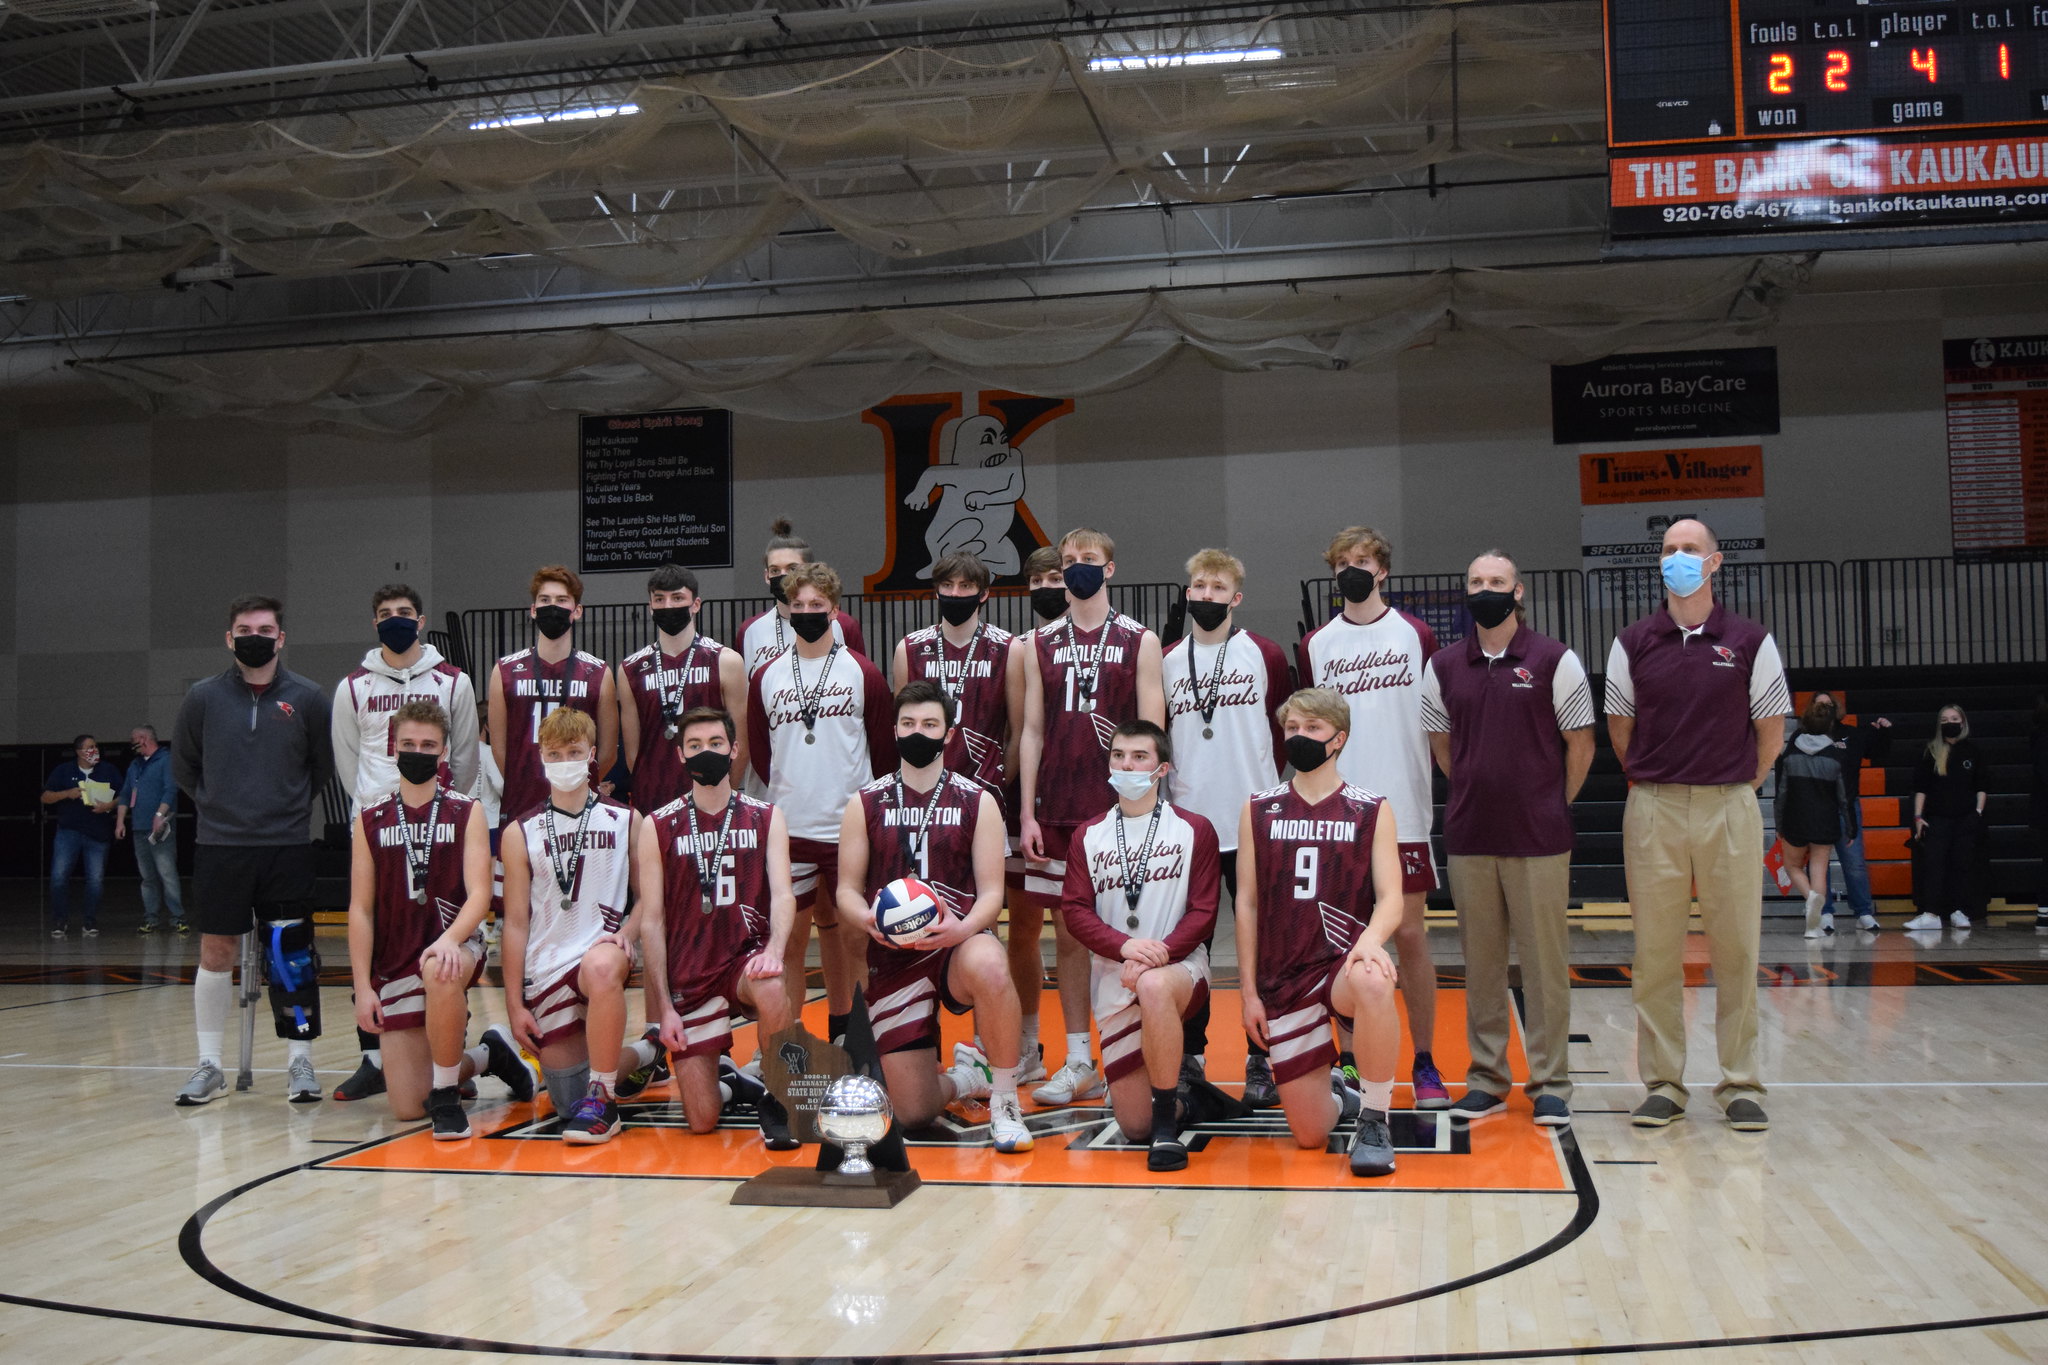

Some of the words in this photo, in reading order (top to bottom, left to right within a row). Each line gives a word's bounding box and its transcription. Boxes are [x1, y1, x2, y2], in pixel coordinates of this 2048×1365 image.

[1750, 22, 1797, 44] fouls
[1881, 12, 1947, 38] player
[1768, 53, 1793, 94] 2
[1826, 50, 1849, 91] 2
[1911, 48, 1936, 83] 4
[2000, 43, 2009, 80] 1
[1758, 108, 1797, 126] won
[1892, 100, 1943, 124] game
[1628, 161, 1697, 198] THE
[1714, 154, 1812, 194] BANK
[1829, 152, 1873, 188] OF
[1663, 202, 1805, 223] 920-766-4674
[1582, 381, 1654, 398] Aurora
[1660, 375, 1747, 398] BayCare
[1600, 405, 1654, 418] SPORTS
[1660, 402, 1732, 415] MEDICINE
[1590, 544, 1662, 556] SPECTATOR
[1322, 648, 1410, 681] Middleton
[1315, 664, 1415, 696] rdinals
[1270, 819, 1356, 842] MIDDLETON
[1293, 847, 1319, 900] 9
[787, 1087, 808, 1097] STATE
